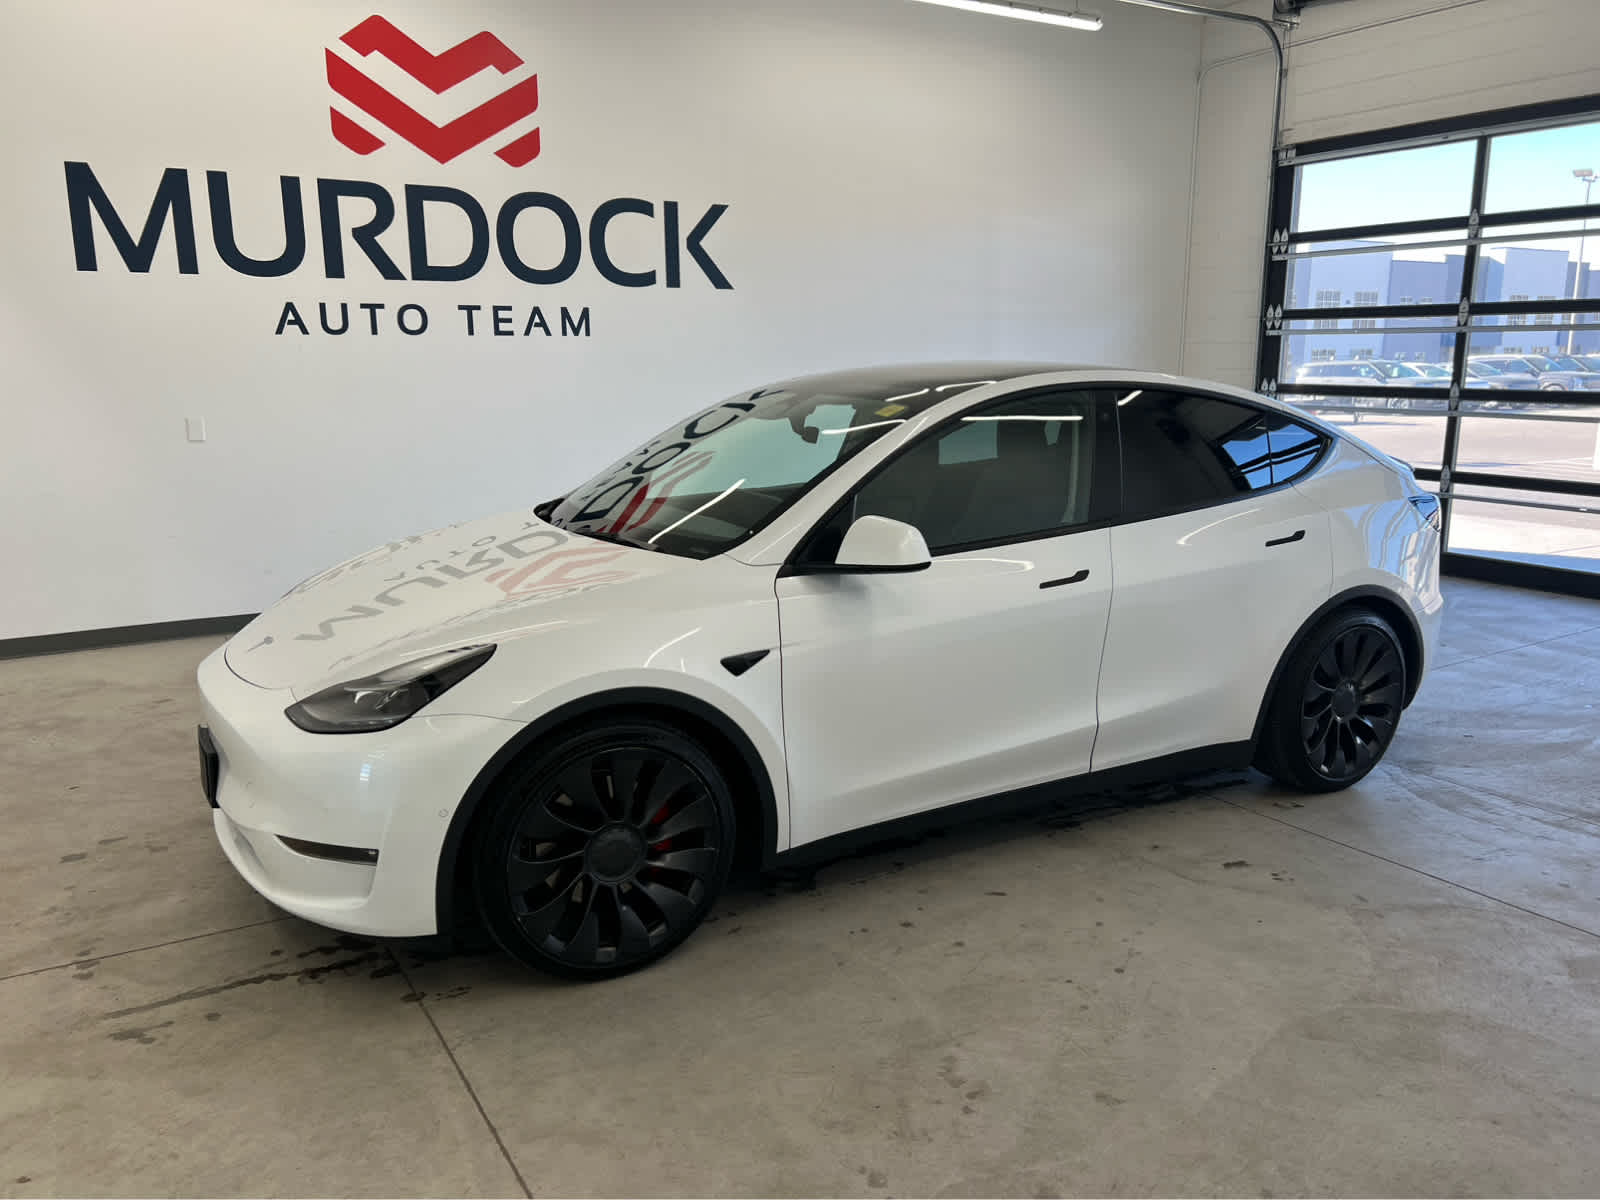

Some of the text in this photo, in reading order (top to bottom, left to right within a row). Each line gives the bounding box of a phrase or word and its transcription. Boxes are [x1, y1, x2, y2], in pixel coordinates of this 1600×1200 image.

[64, 161, 734, 290] MURDOCK
[275, 301, 592, 337] AUTO TEAM
